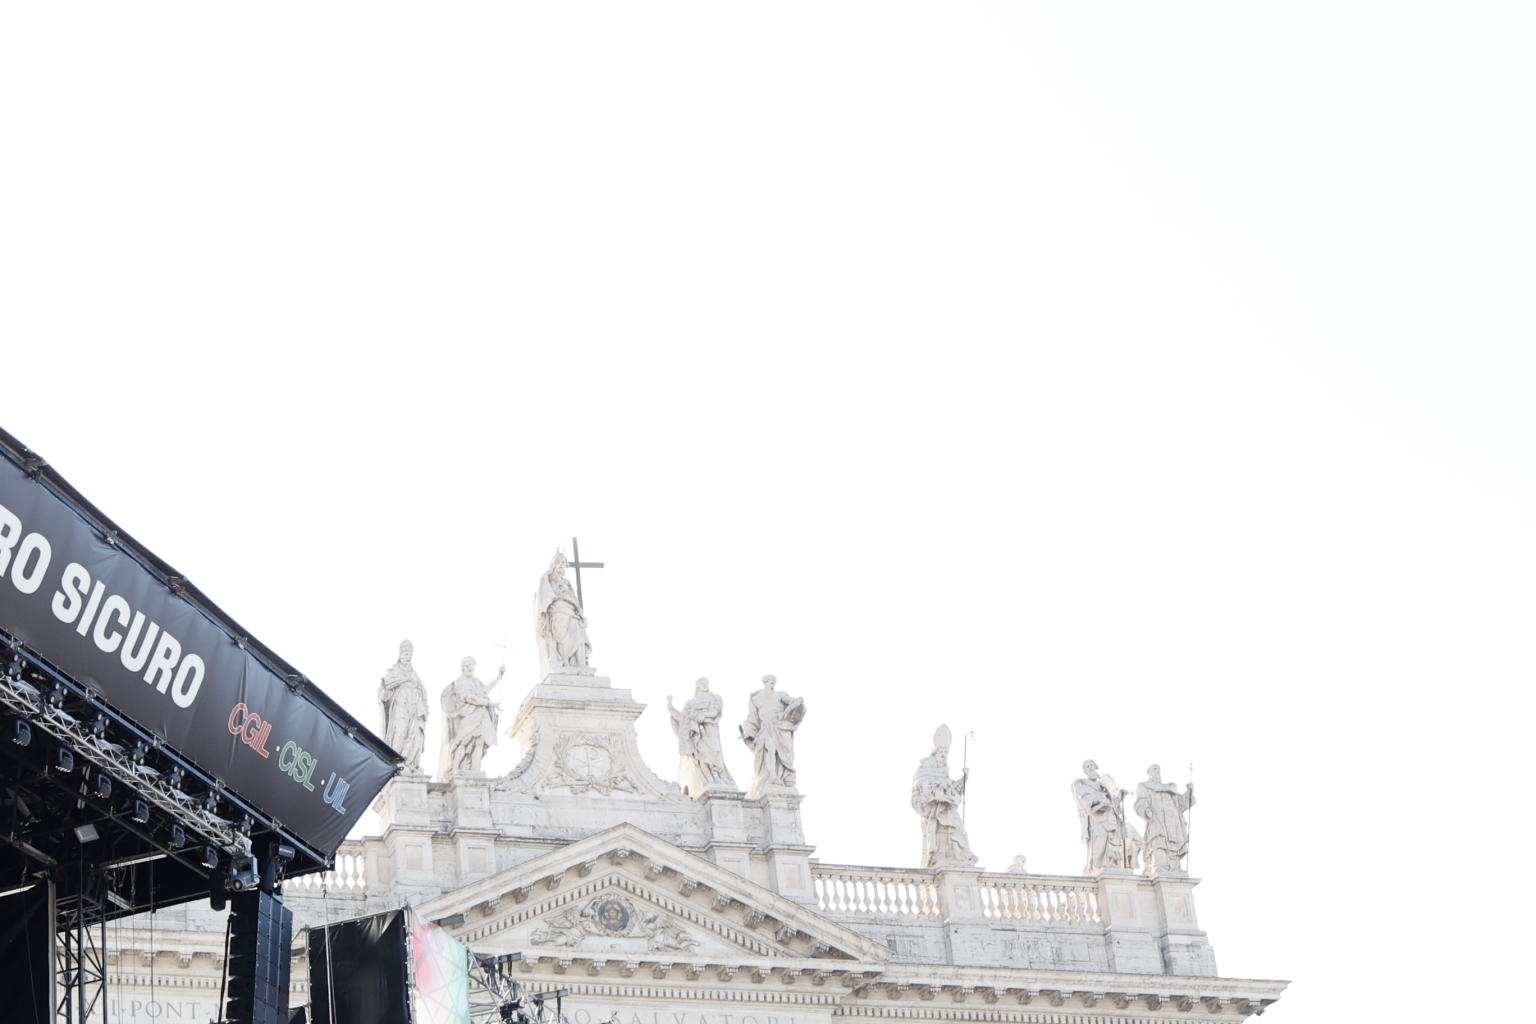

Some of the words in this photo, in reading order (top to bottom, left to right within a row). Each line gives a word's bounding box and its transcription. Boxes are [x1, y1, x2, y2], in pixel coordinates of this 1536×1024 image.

[51, 562, 206, 709] SICURO
[228, 702, 272, 759] CGIL
[278, 740, 318, 792] CISL
[323, 771, 351, 815] UIL
[131, 1000, 201, 1019] PONT
